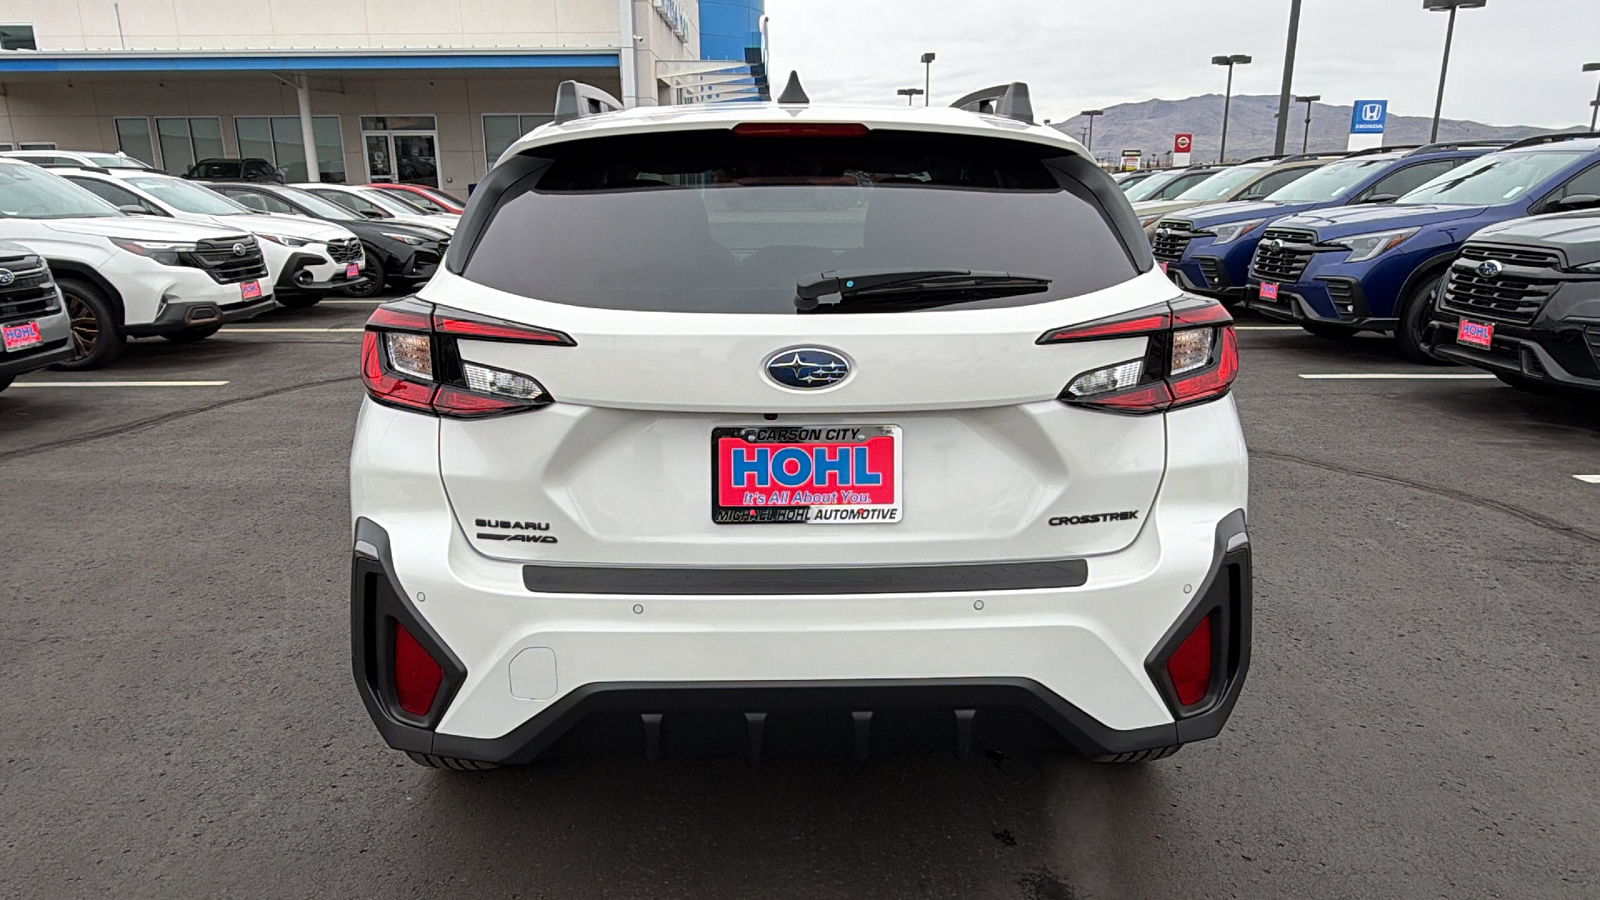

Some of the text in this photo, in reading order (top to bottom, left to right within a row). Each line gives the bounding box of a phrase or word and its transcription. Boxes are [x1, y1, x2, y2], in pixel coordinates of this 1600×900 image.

[6, 326, 37, 339] HOHL
[1462, 324, 1489, 338] HOHL
[756, 428, 861, 441] CARSON CITY
[731, 446, 882, 487] HOHL
[743, 490, 872, 504] It's All About You.
[716, 508, 898, 522] MICHAEL HOHL AUTOMOTIVE
[1048, 509, 1139, 526] CROSSTREK
[475, 518, 550, 531] SUBARU
[506, 534, 558, 544] AWD
